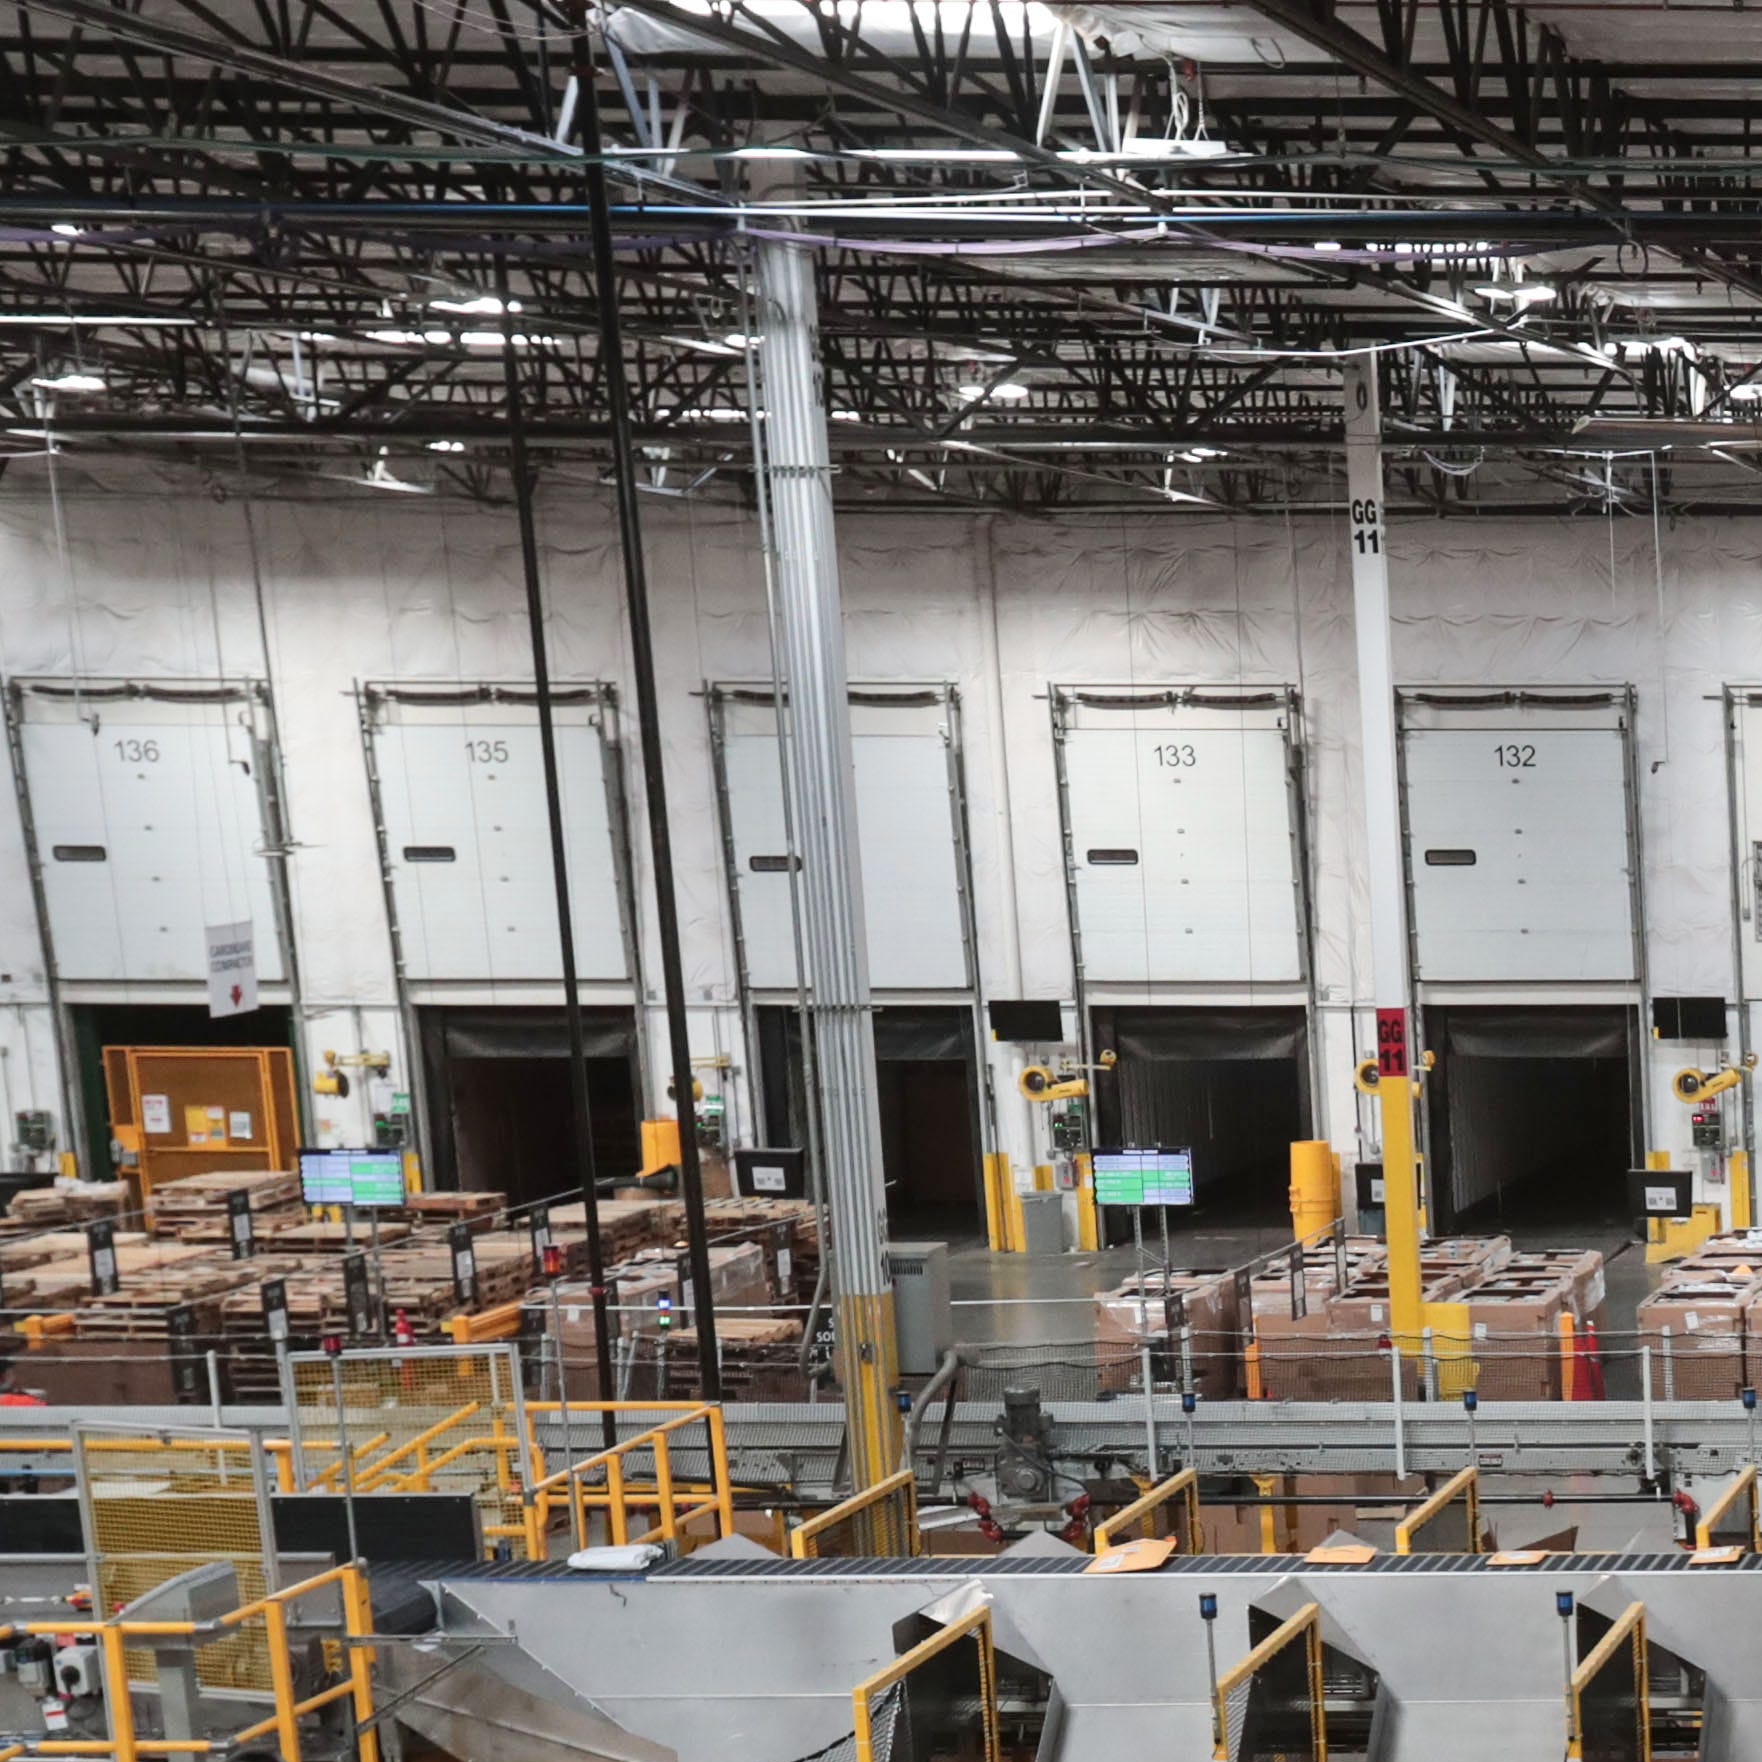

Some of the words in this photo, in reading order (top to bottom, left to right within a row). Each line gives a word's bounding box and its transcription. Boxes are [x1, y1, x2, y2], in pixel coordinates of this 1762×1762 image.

[1352, 499, 1377, 525] GG
[1354, 529, 1379, 554] 11
[113, 739, 160, 763] 136
[464, 740, 508, 763] 135
[1153, 744, 1197, 768] 133
[1494, 744, 1537, 768] 132
[1378, 1018, 1403, 1043] GG
[1379, 1048, 1404, 1072] 11
